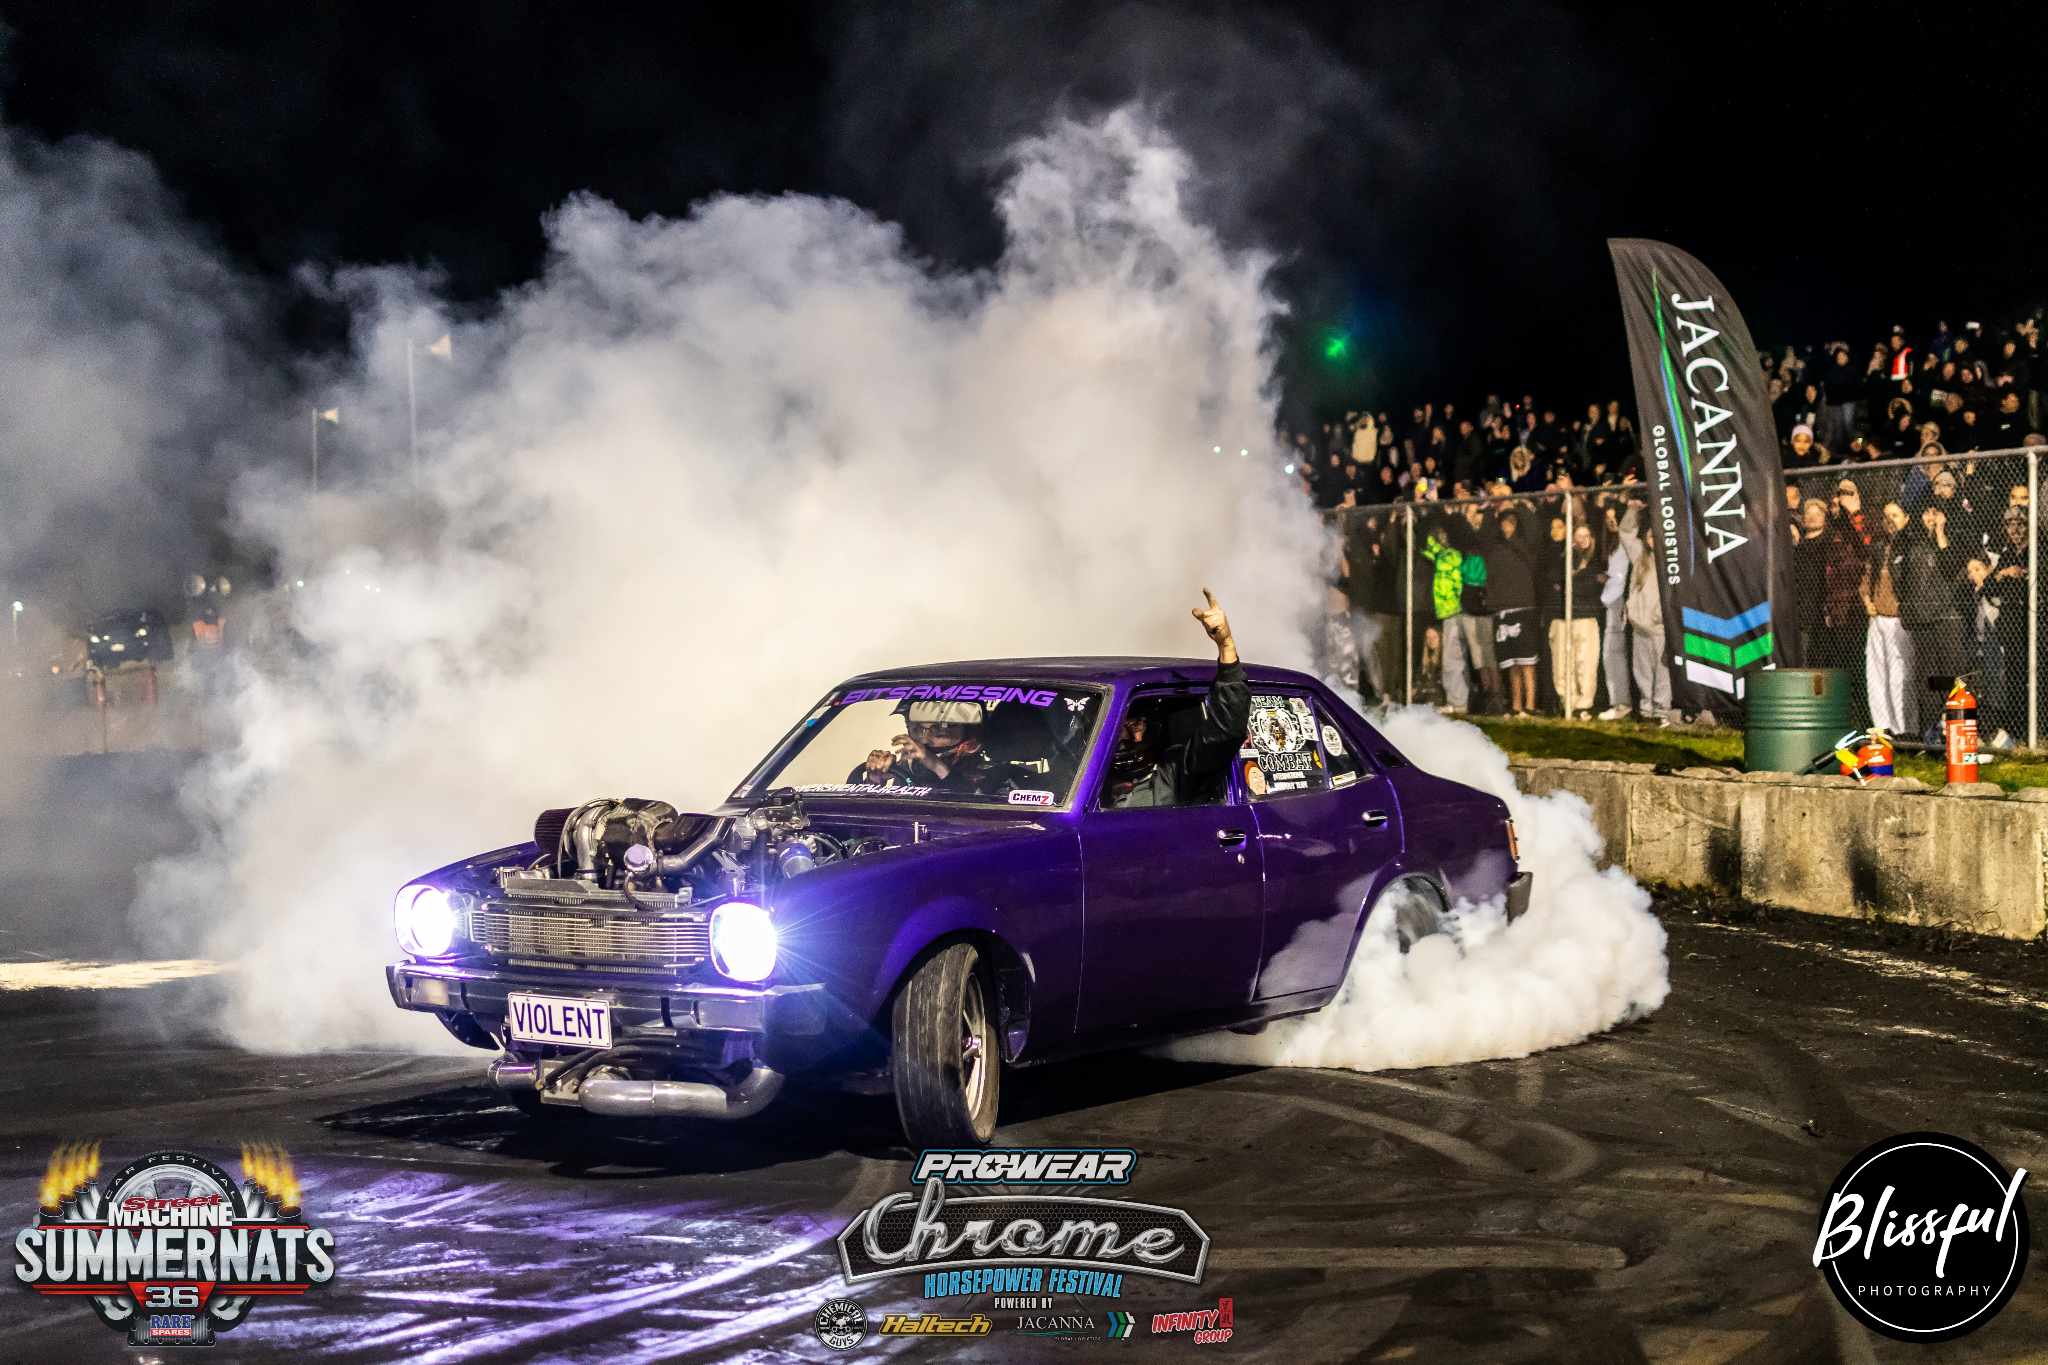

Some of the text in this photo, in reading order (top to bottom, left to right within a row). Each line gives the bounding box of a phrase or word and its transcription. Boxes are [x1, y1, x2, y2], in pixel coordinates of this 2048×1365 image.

[1671, 293, 1749, 564] JACANNA
[1652, 424, 1681, 585] GLOBAL LOGISTICS
[840, 683, 1058, 707] BITSAMISSING
[1258, 753, 1312, 772] COMBAT
[513, 1001, 605, 1040] VIOLENT
